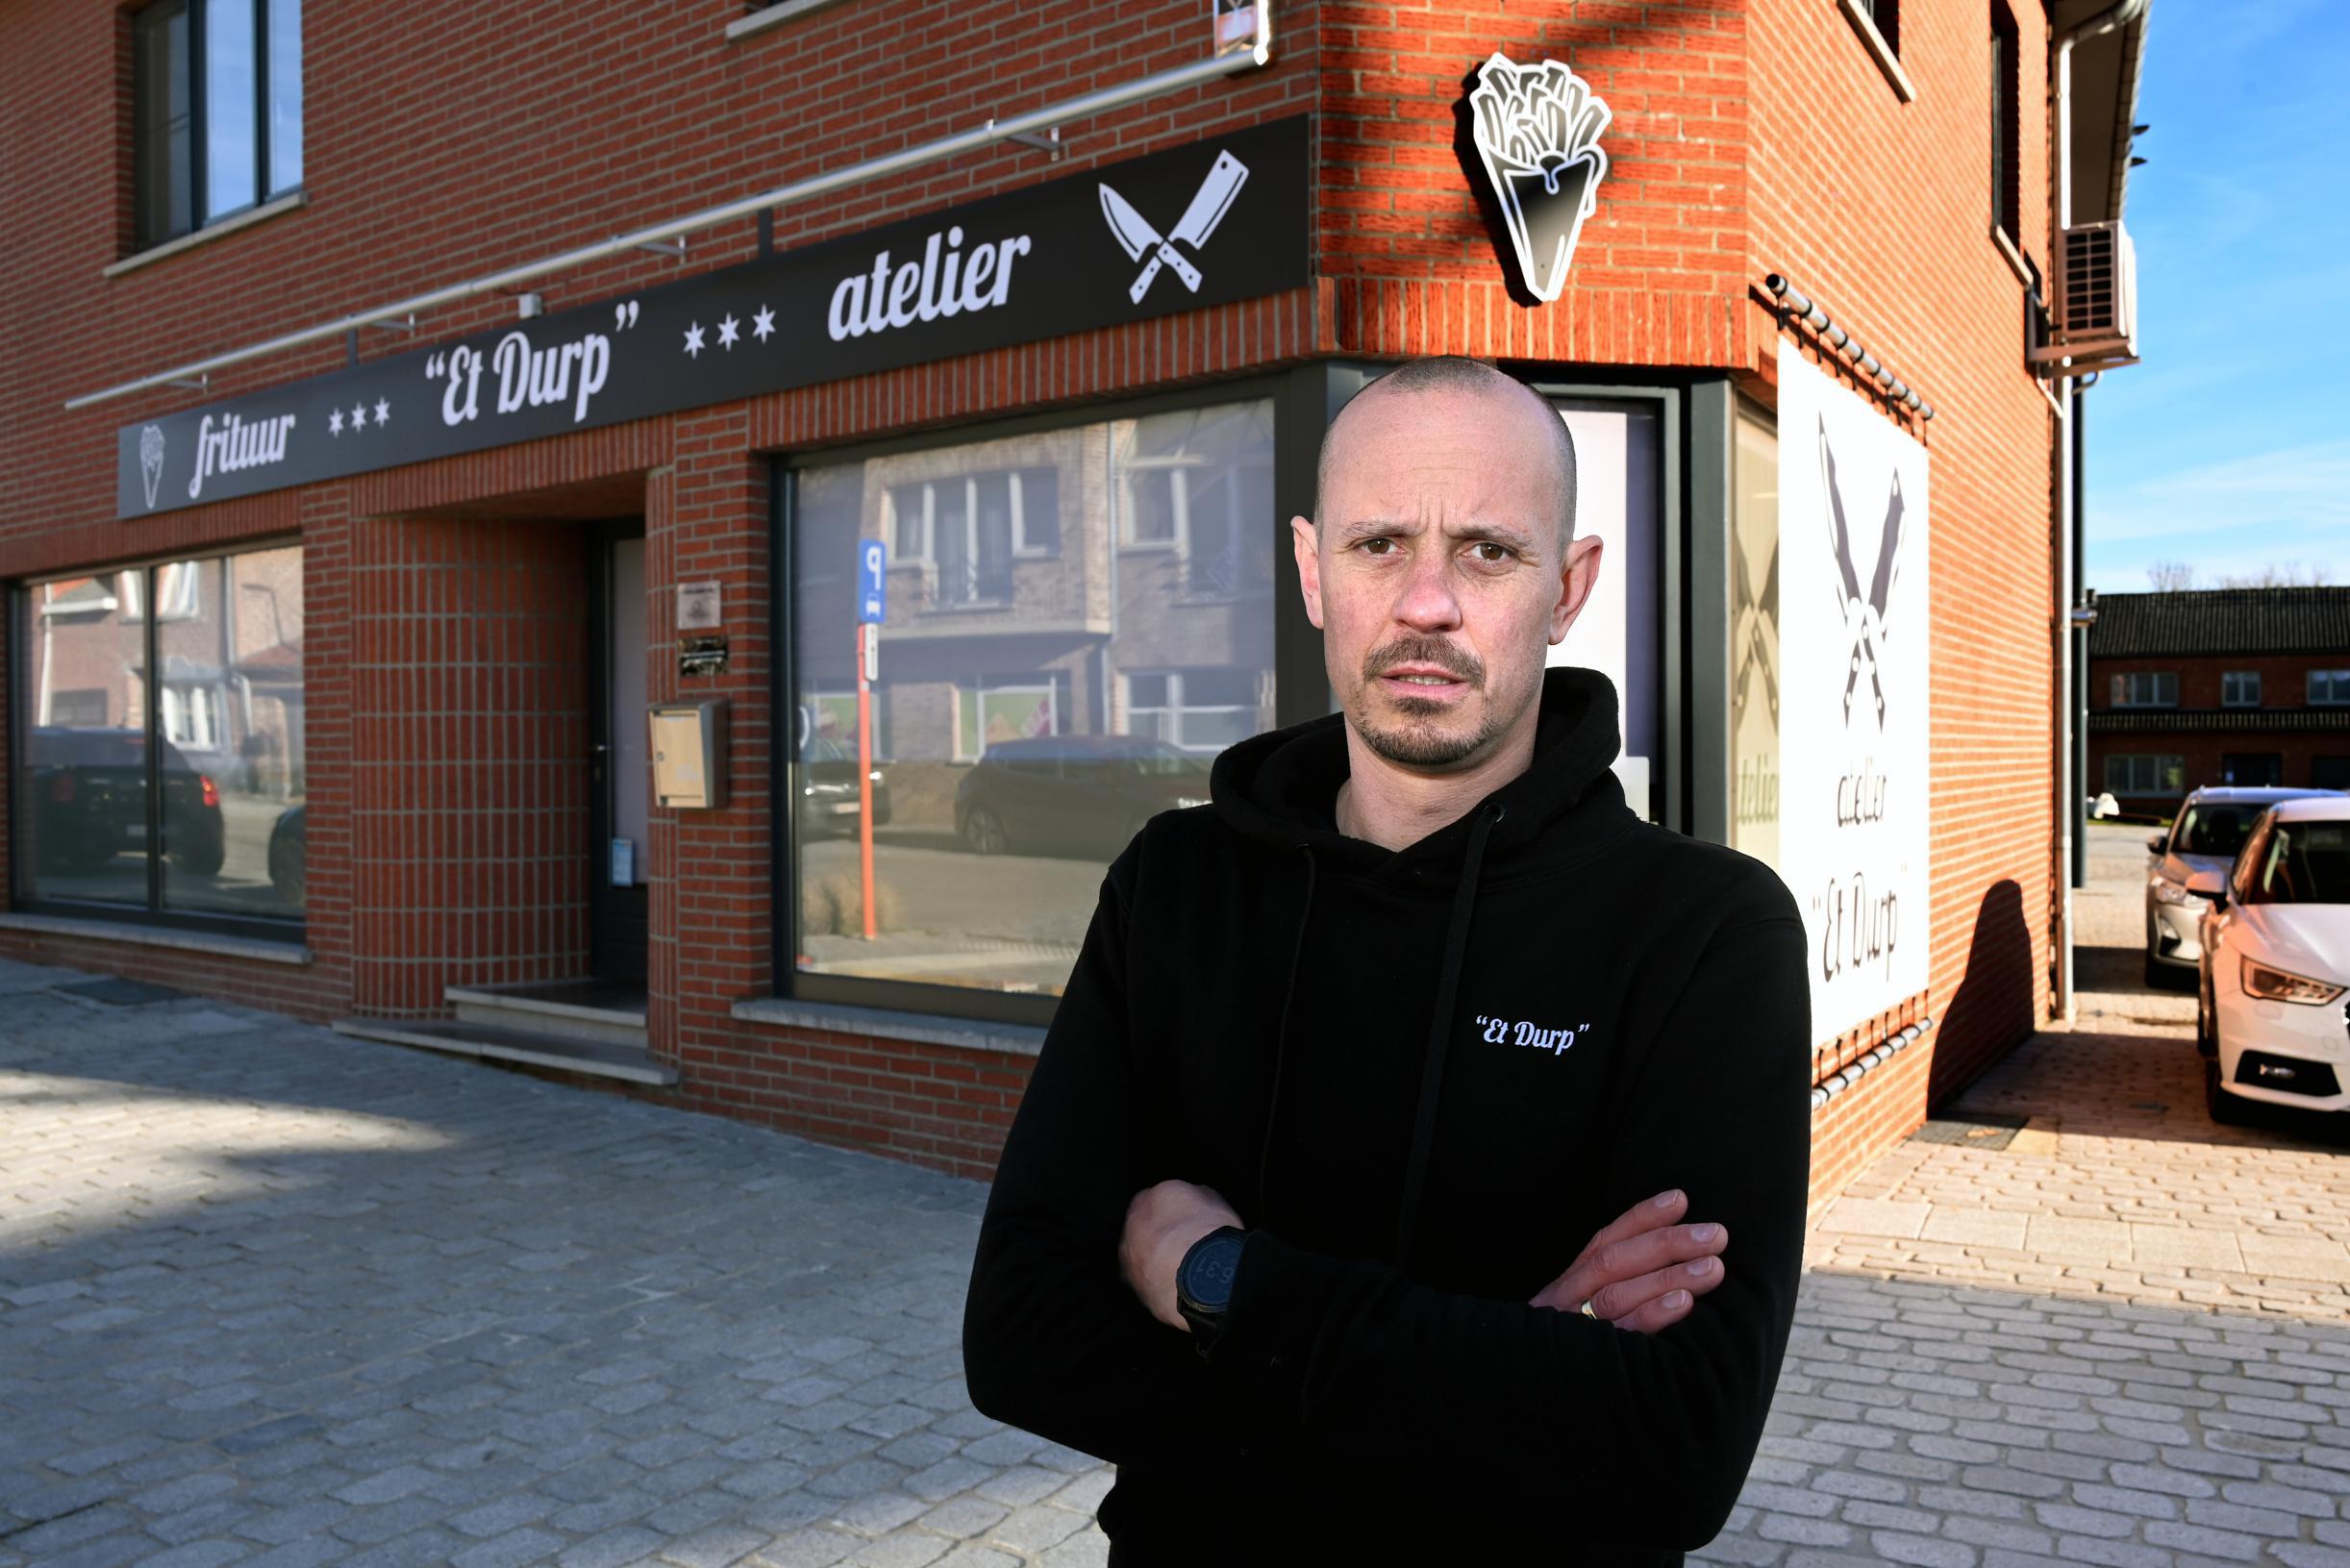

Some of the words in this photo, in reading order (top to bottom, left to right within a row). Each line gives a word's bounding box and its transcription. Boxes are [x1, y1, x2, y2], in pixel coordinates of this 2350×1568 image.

[188, 412, 296, 499] frituur
[425, 344, 484, 426] “Et
[492, 300, 639, 423] Durp”
[828, 225, 1032, 341] atelier
[1838, 756, 1888, 828] atelier
[1476, 1015, 1509, 1044] “Et
[1513, 1021, 1590, 1056] Durp”
